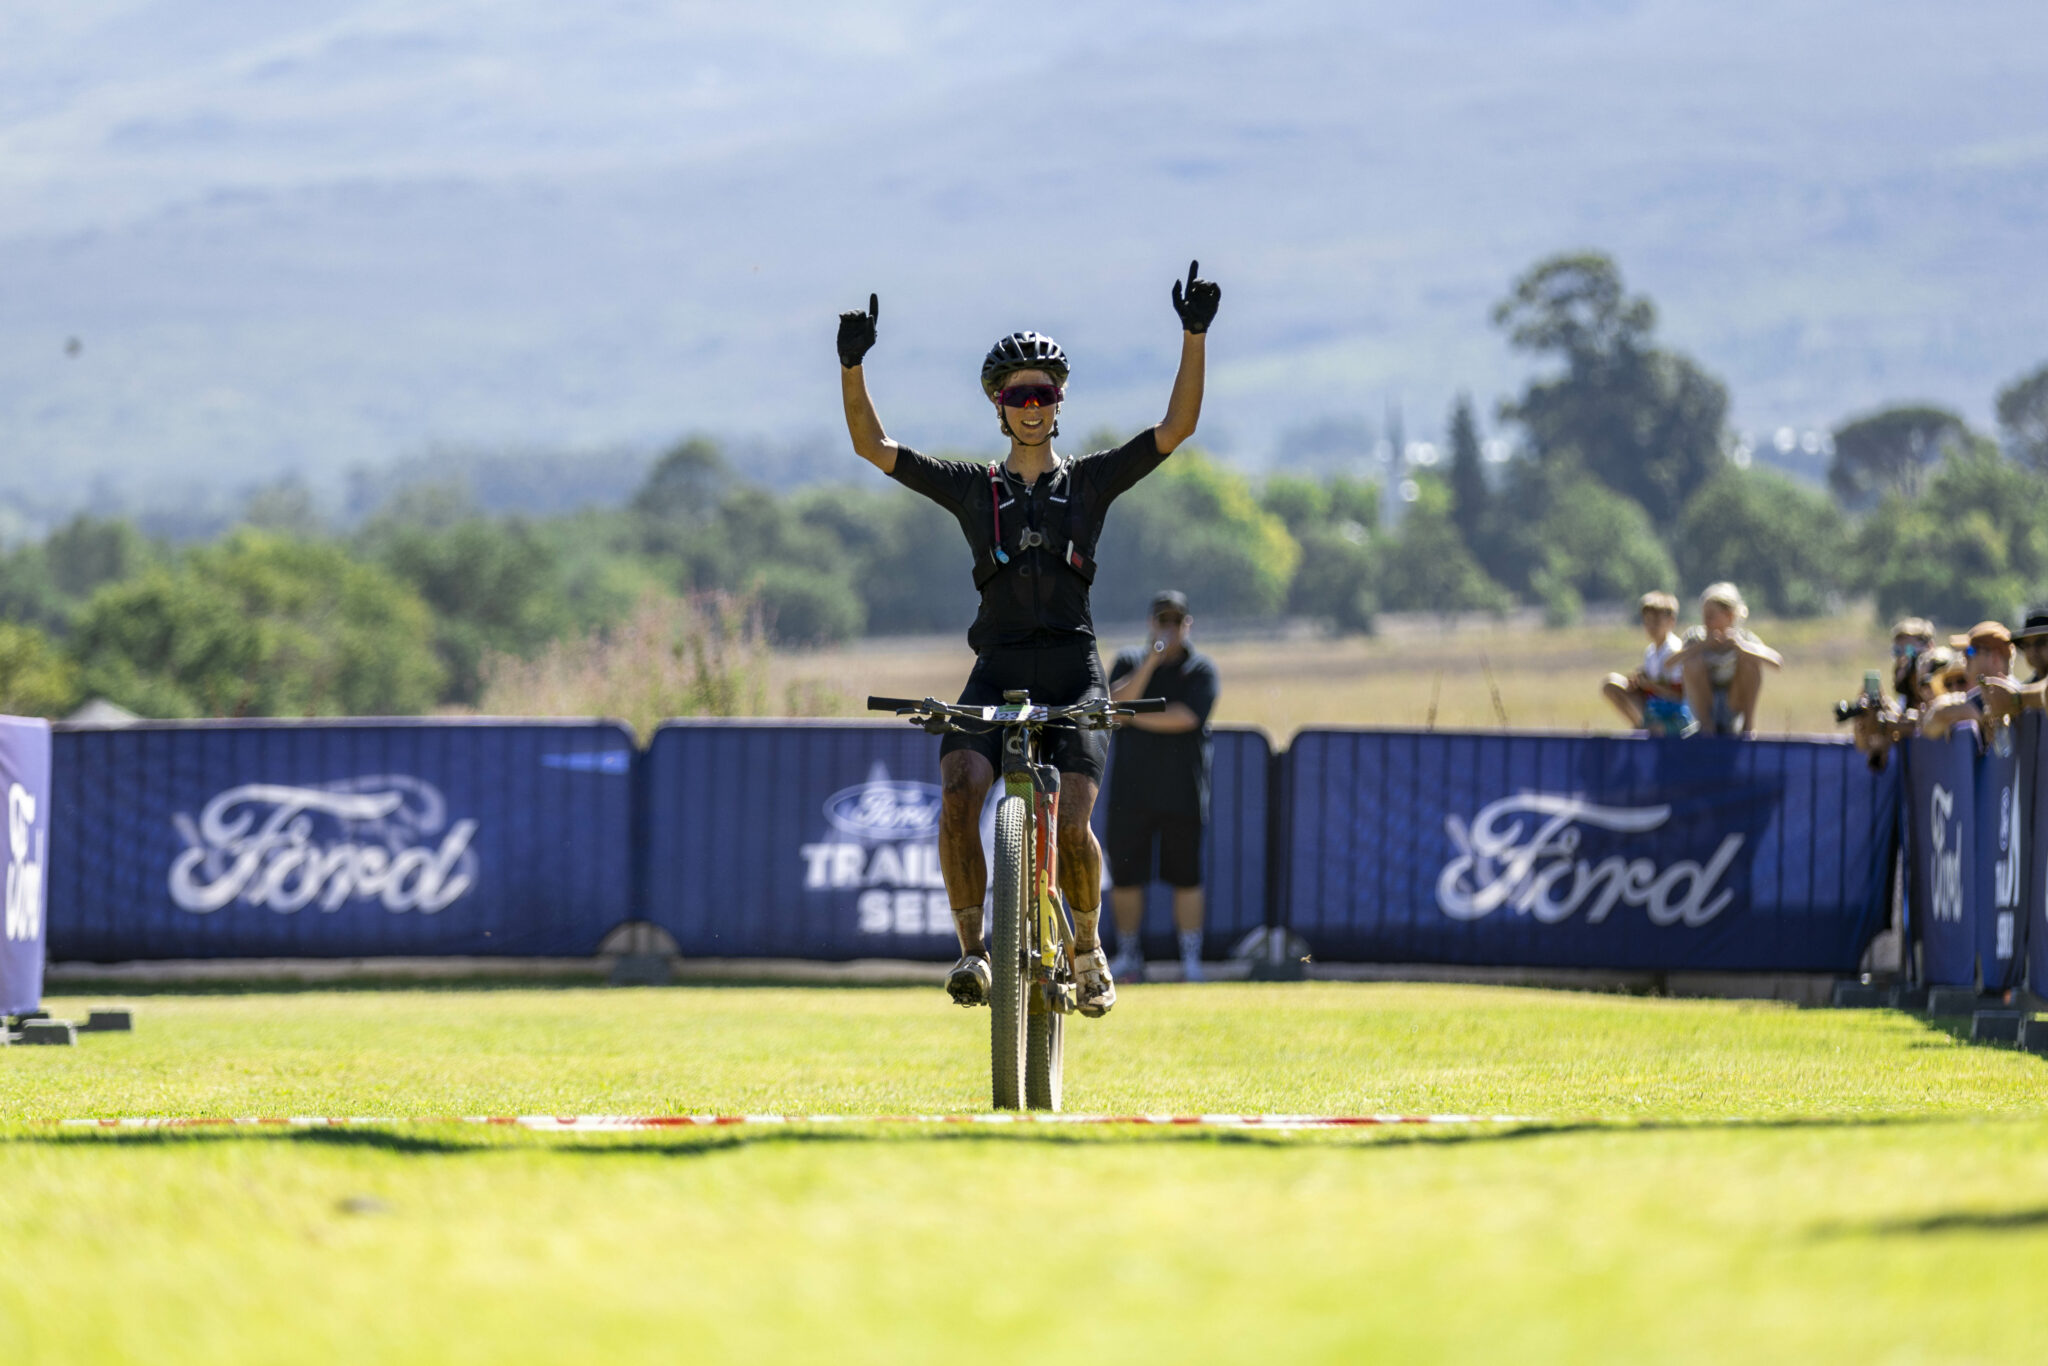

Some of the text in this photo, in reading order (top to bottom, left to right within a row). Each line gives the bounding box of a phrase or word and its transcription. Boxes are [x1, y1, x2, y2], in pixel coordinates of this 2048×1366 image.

[168, 781, 479, 914] Ford
[850, 787, 942, 831] Ford
[1436, 792, 1745, 926] Ford
[857, 888, 957, 936] SEE
